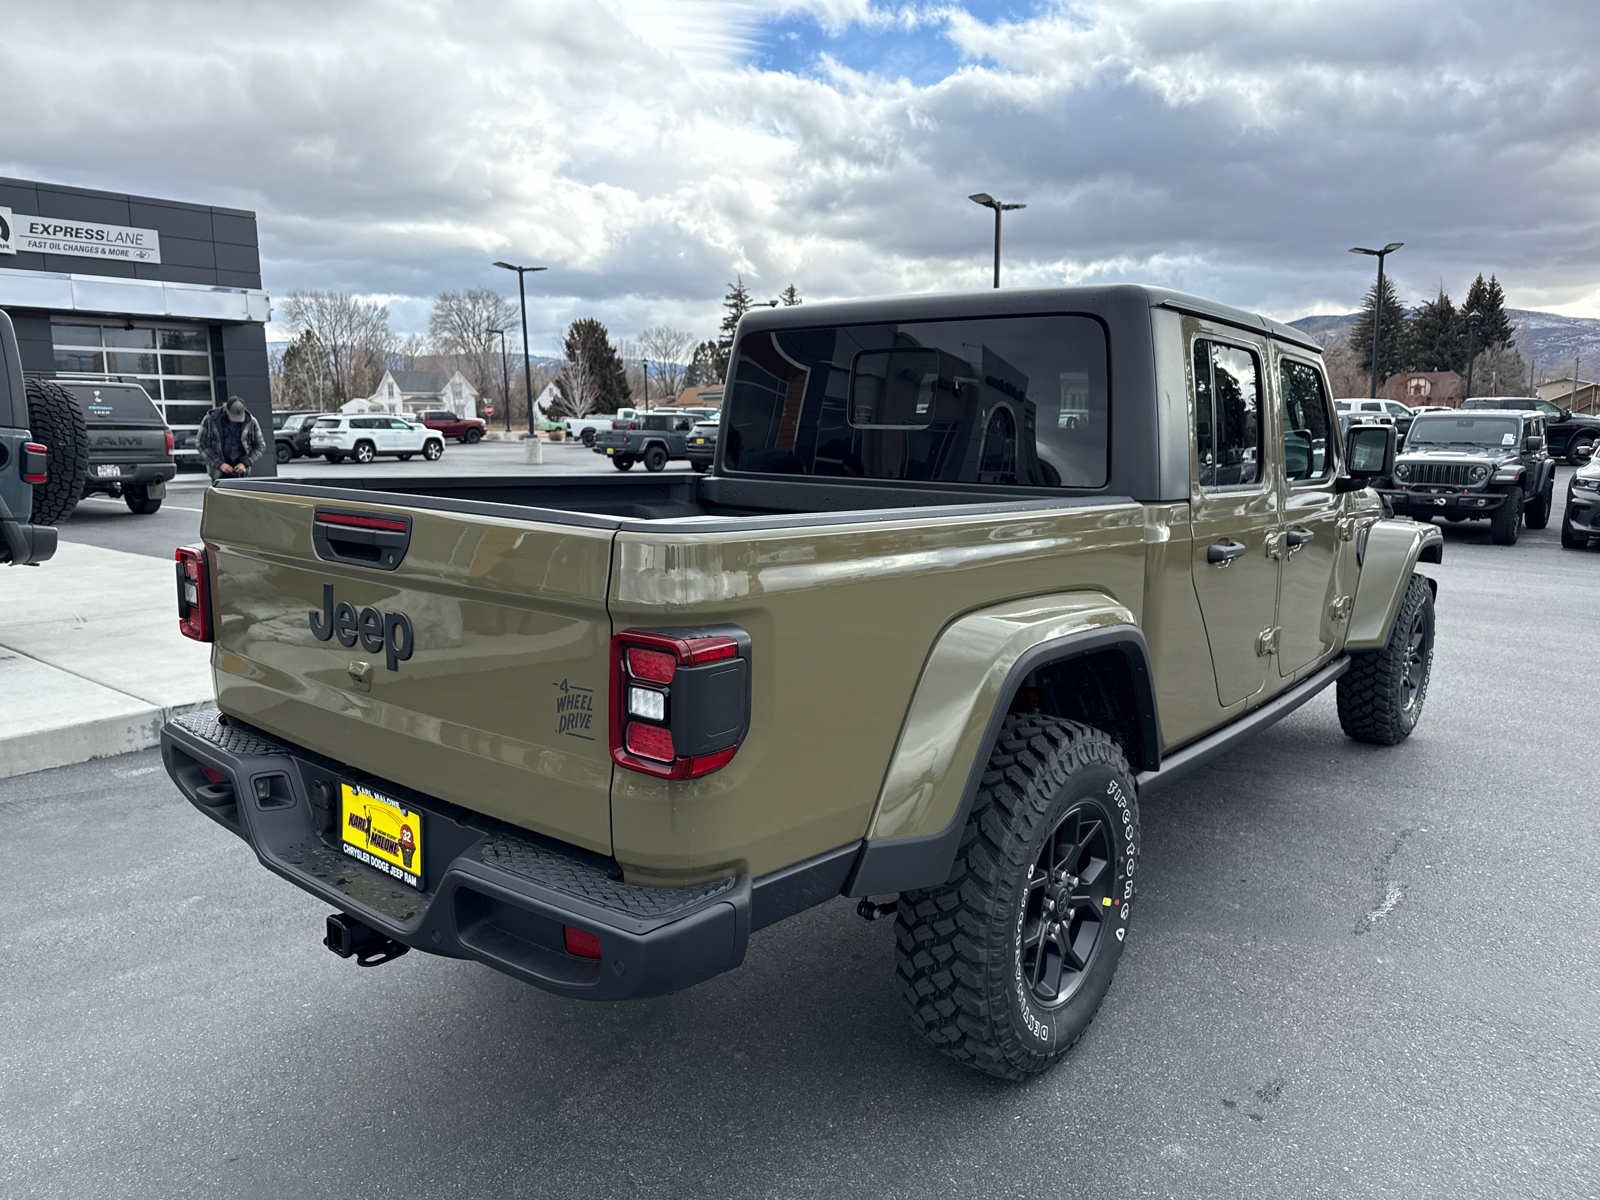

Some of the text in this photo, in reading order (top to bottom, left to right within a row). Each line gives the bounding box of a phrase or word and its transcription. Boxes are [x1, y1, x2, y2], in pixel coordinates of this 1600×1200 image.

[29, 222, 144, 246] EXPRESSLANE
[27, 240, 48, 249] FAST
[49, 242, 61, 250] OIL
[63, 243, 99, 254] CHANGES
[108, 248, 129, 257] MORE
[88, 436, 143, 446] AM
[309, 583, 414, 672] Jeep
[559, 678, 569, 694] 4
[556, 694, 593, 714] WHEEL
[559, 712, 593, 734] DRIVE
[356, 785, 400, 809] KARL MALONE
[348, 812, 367, 833] KARL
[370, 831, 400, 856] MALONE
[402, 829, 412, 843] 32
[343, 843, 417, 887] CHRYSLER DODGE JEEP RAM
